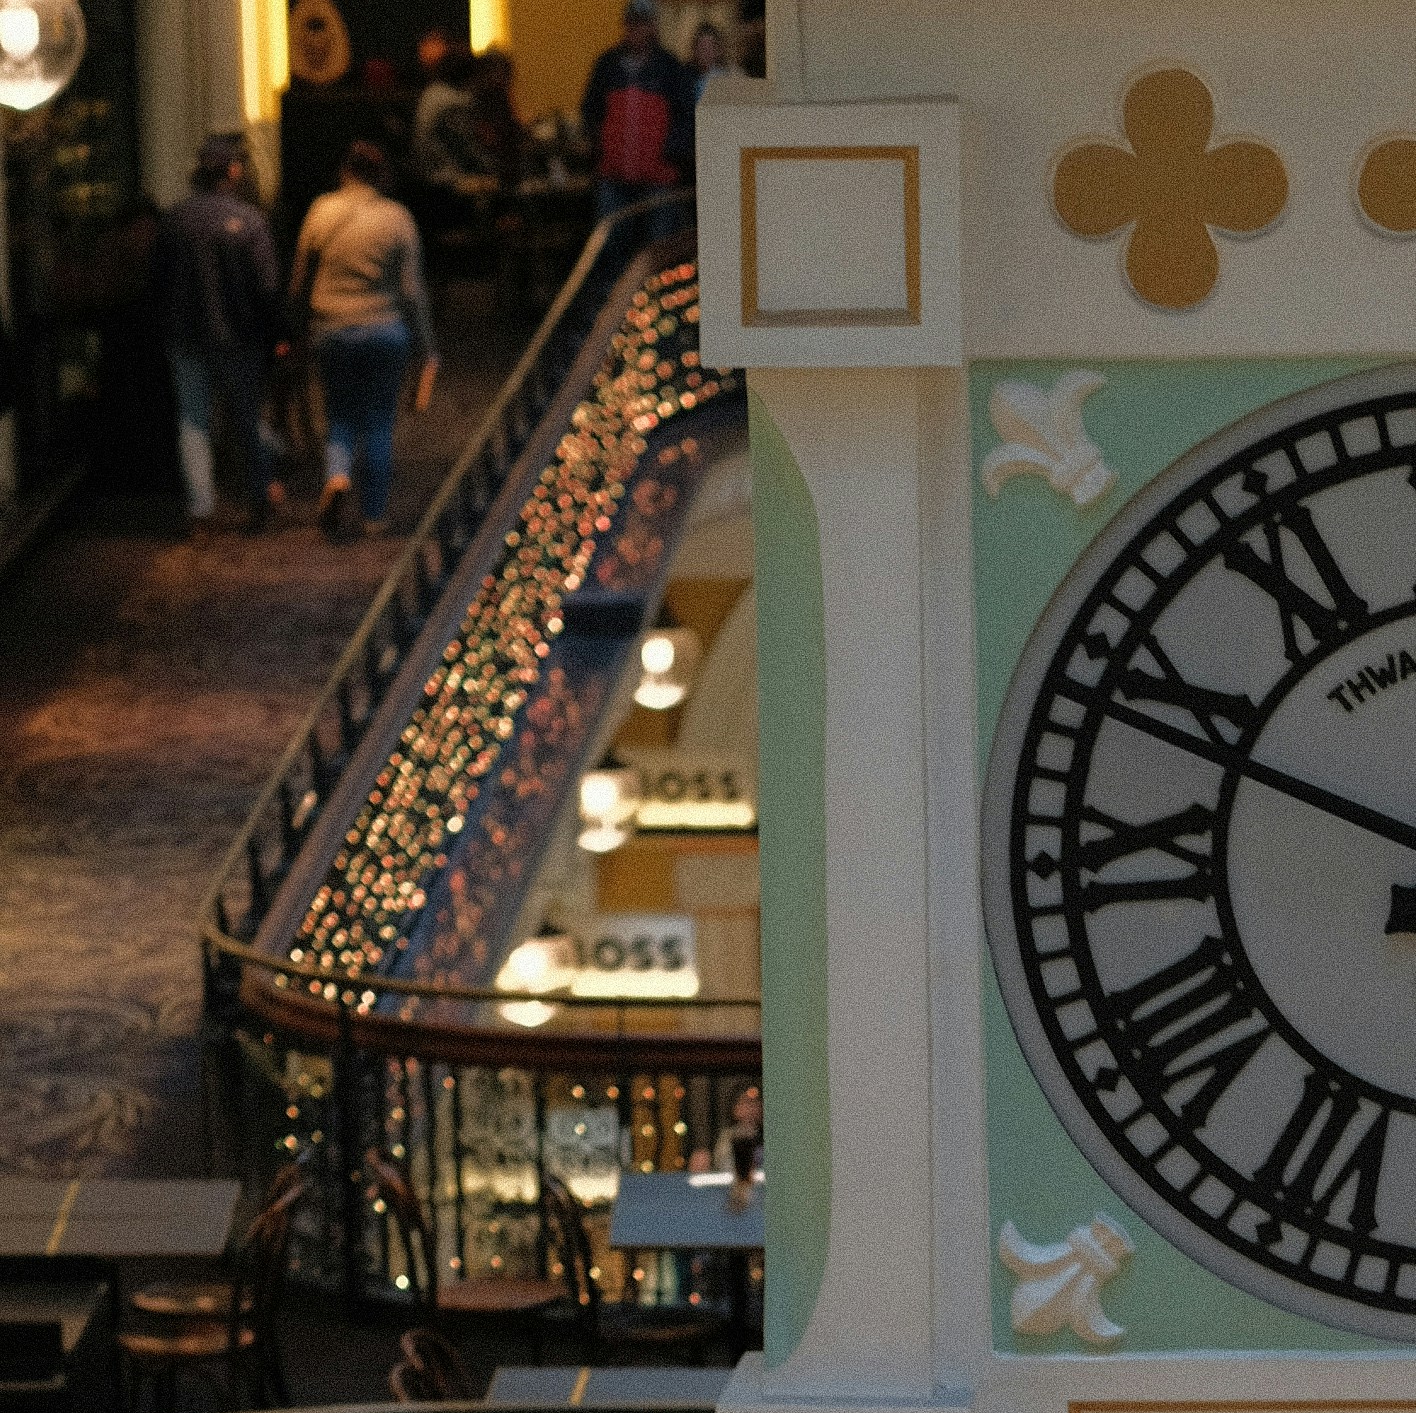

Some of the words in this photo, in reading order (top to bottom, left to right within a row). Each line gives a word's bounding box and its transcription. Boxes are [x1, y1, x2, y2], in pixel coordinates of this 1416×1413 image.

[1224, 501, 1371, 664] XI
[1112, 630, 1258, 750] X
[640, 770, 739, 801] OSS
[1079, 803, 1215, 913] IX
[575, 936, 685, 970] OSS
[1104, 935, 1273, 1129] VIII
[1252, 1070, 1389, 1232] VII
